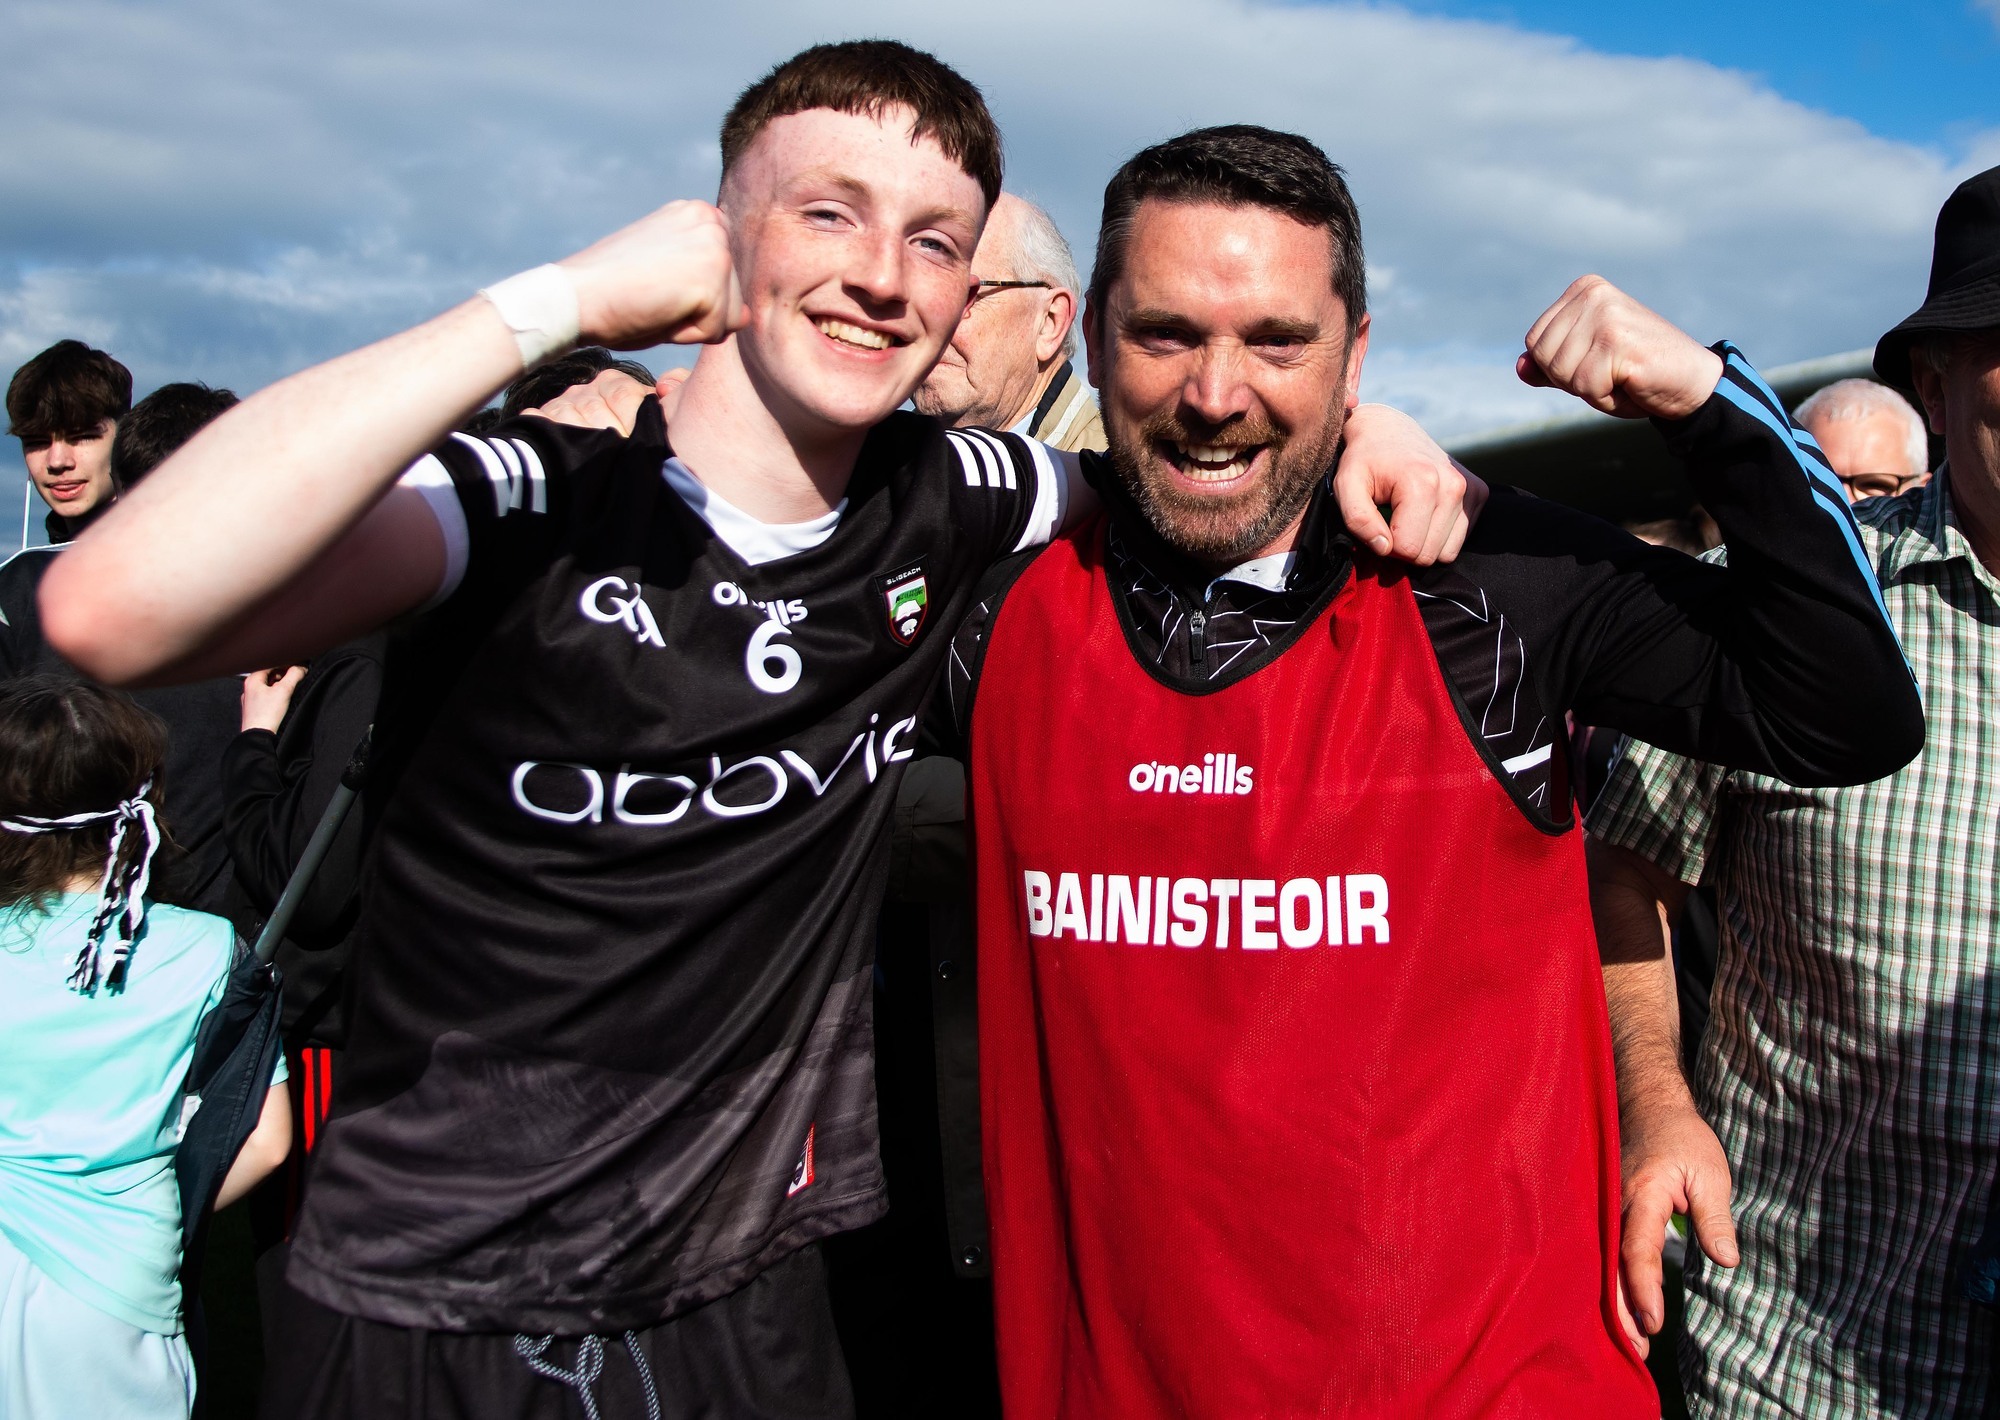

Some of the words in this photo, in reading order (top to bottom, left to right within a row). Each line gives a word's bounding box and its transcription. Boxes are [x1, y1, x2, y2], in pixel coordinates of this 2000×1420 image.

[747, 619, 802, 694] 6
[512, 712, 917, 825] abbvie
[1128, 752, 1254, 796] o'neills
[1023, 869, 1391, 951] BAINISTEOIR
